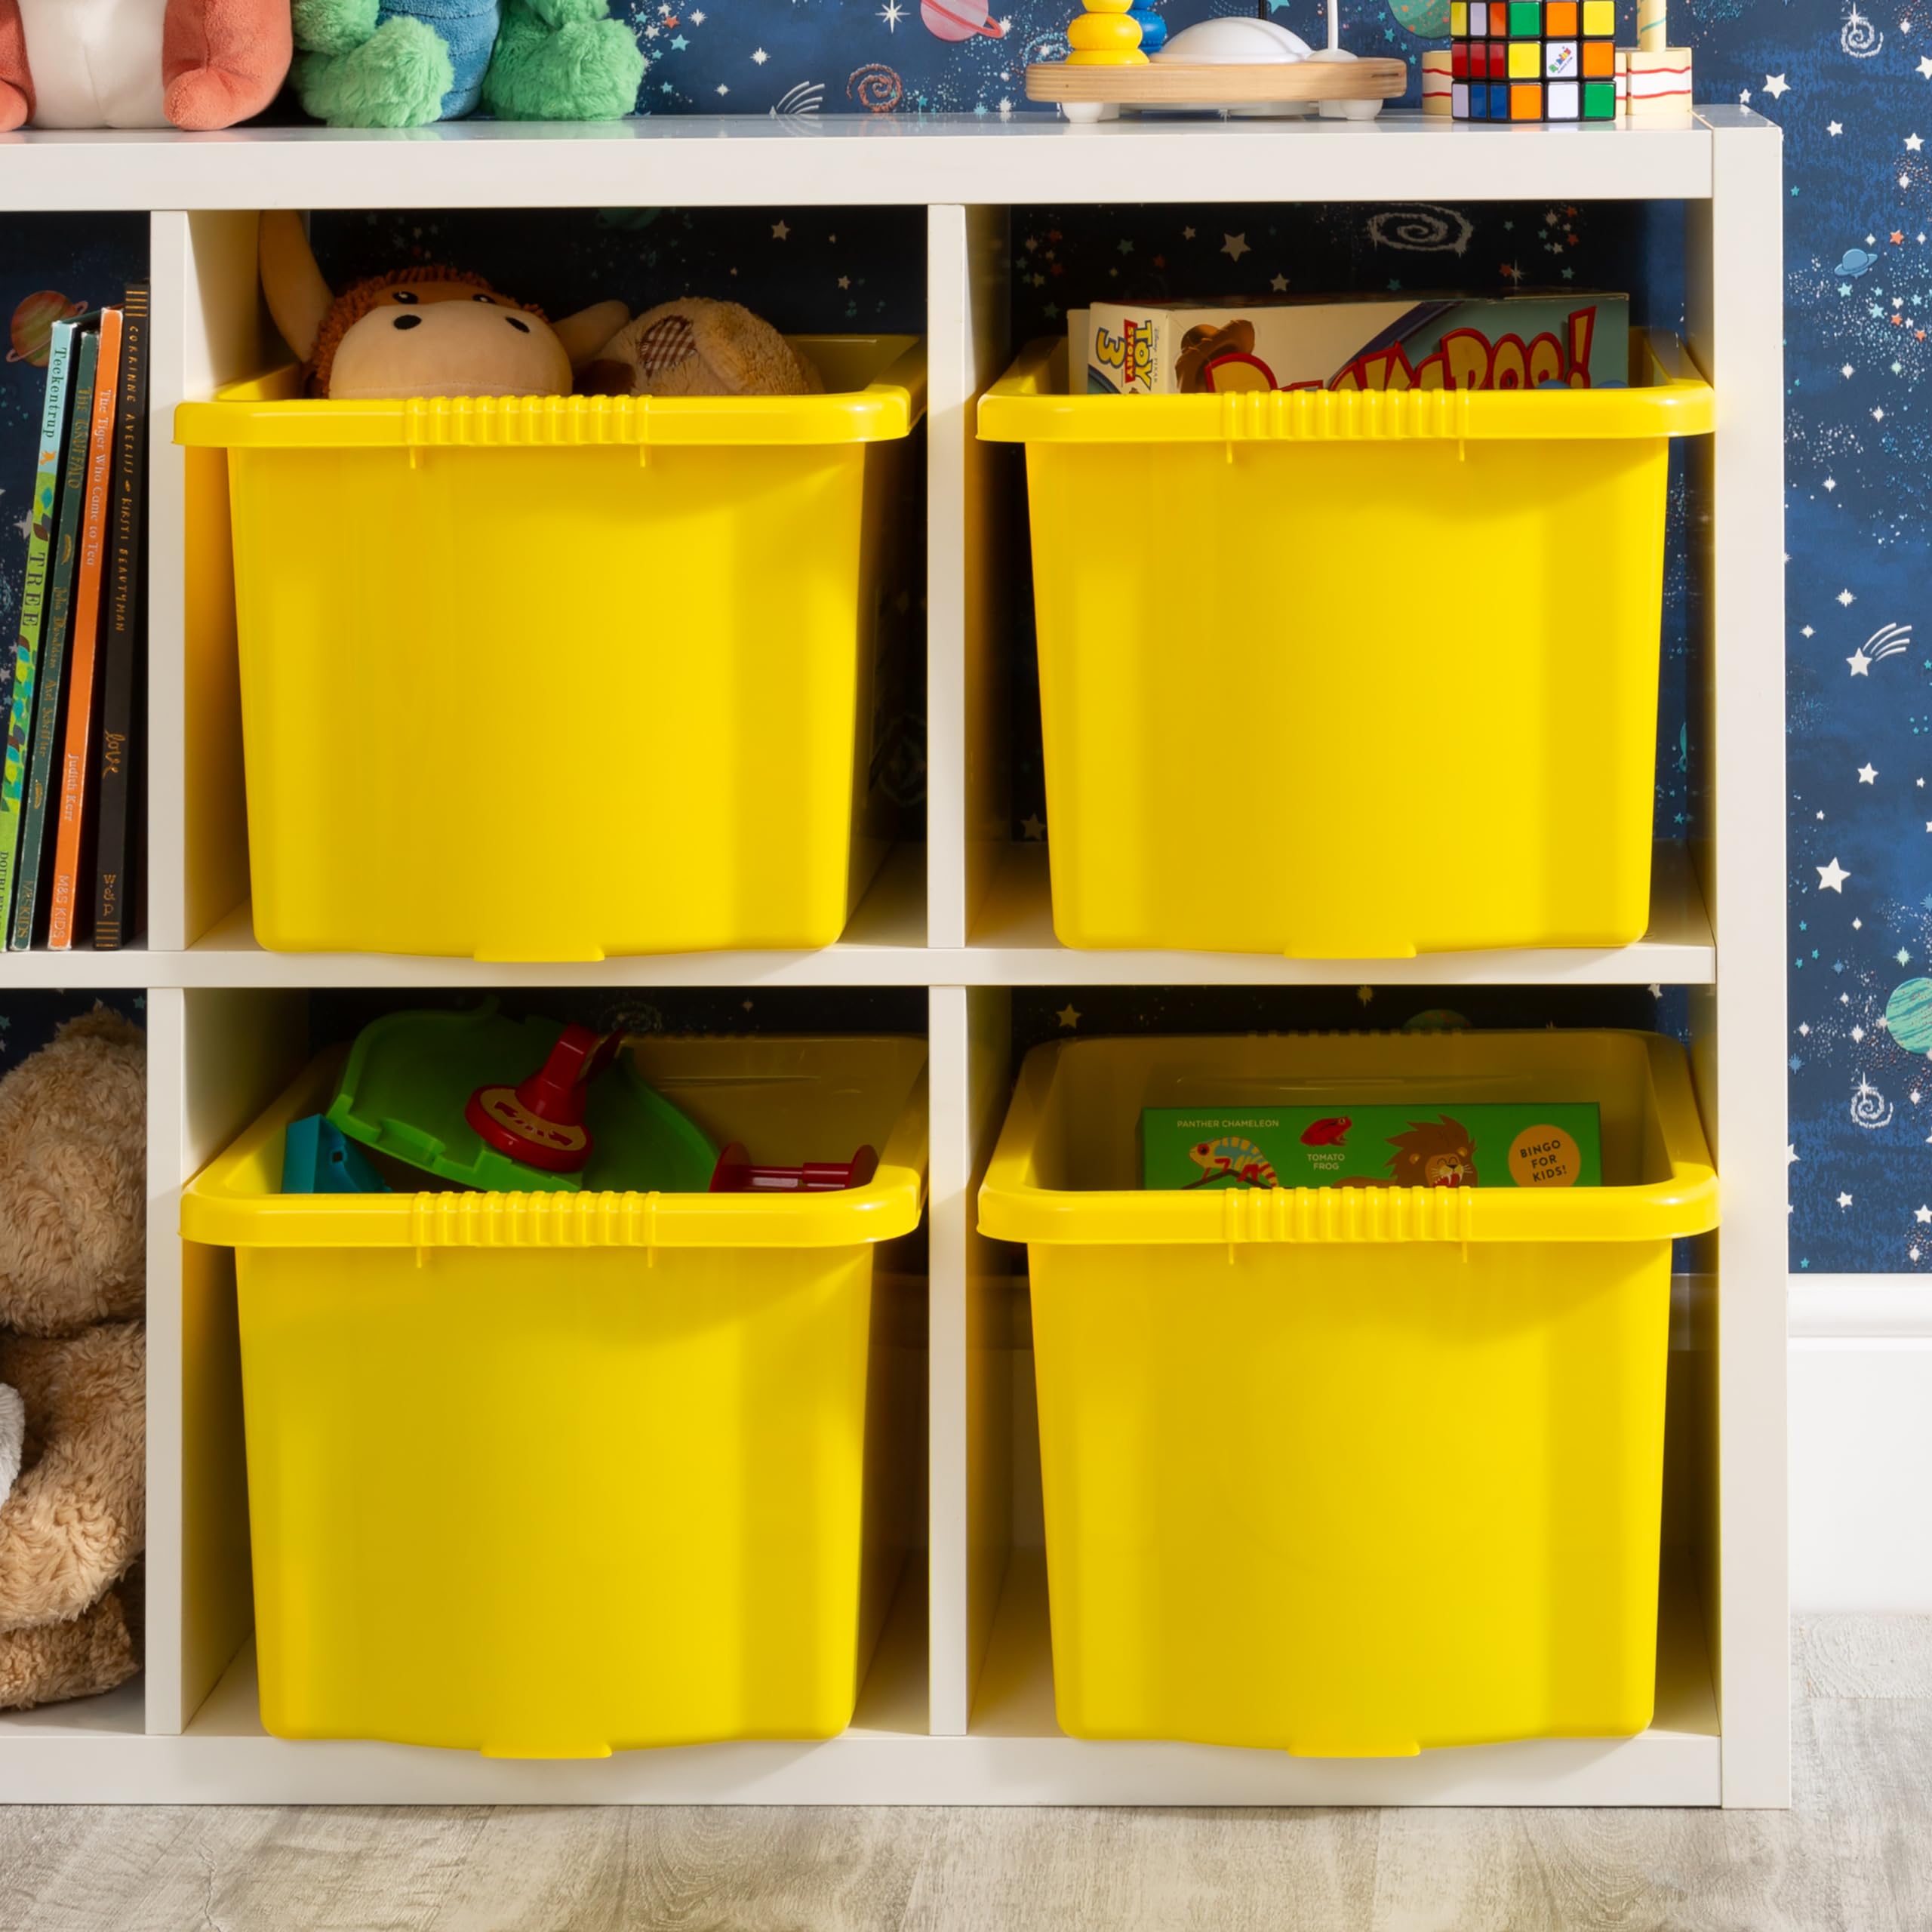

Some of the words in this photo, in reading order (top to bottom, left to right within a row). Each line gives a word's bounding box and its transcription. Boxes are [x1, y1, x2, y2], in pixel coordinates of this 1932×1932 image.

[1096, 327, 1126, 369] 3
[1135, 320, 1153, 391] TOY
[42, 347, 67, 438] Teckentrup
[97, 389, 112, 412] The
[94, 417, 109, 449] Tiger
[93, 454, 107, 482] Who
[91, 488, 103, 523] Came
[89, 526, 98, 538] to
[86, 542, 100, 566] Tea
[23, 552, 45, 626] TREE
[115, 548, 128, 632] BEAUTYMAN
[102, 730, 126, 780] love
[66, 752, 79, 792] Judith
[65, 793, 77, 821] Kerr
[55, 873, 70, 905] M&S
[51, 908, 67, 939] KIDS
[1177, 1120, 1220, 1129] PANTHER
[1221, 1119, 1279, 1128] CHAMELEON
[1307, 1153, 1346, 1162] TOMATO
[1520, 1140, 1561, 1158] BINGO
[1531, 1155, 1558, 1168] FOR
[1313, 1161, 1340, 1171] FROG
[1532, 1165, 1567, 1182] KIDS!
